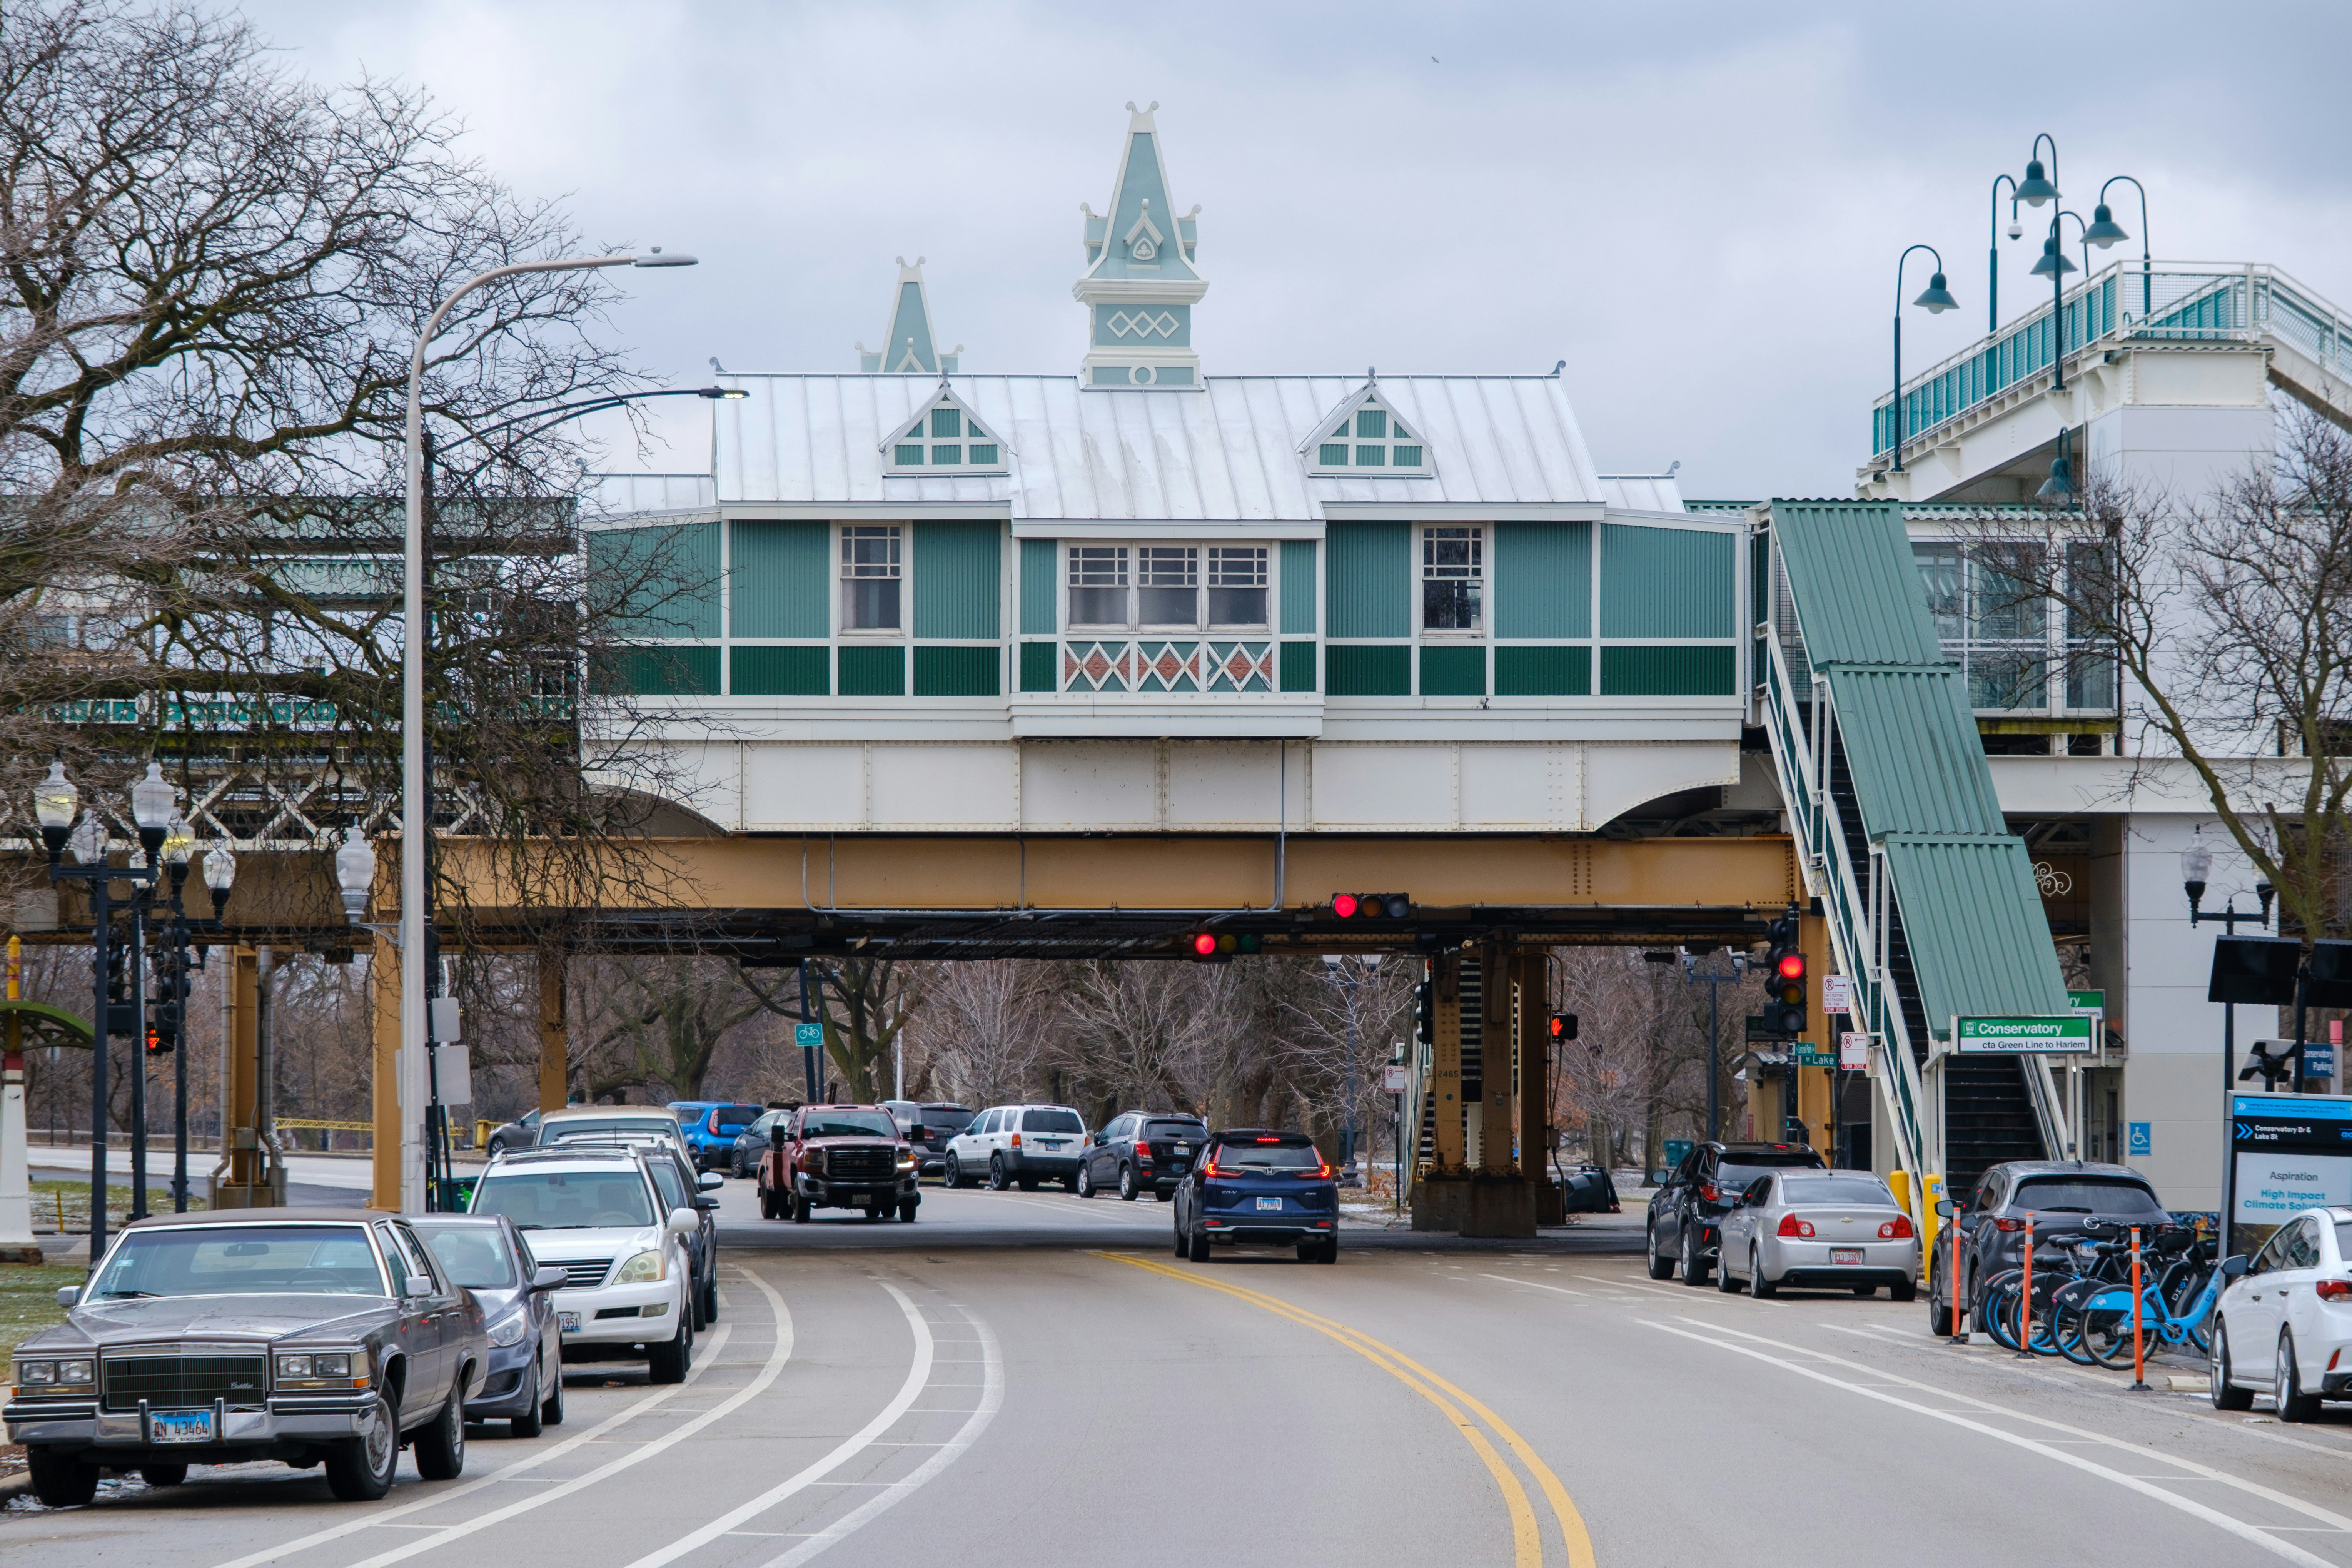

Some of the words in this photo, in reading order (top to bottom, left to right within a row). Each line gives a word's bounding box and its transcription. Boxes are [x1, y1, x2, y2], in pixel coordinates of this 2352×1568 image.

[1978, 1023, 2062, 1036] Conservatory
[2056, 1040, 2085, 1049] Harlem
[1813, 1055, 1835, 1064] Lake
[2304, 1049, 2333, 1061] onservatory
[2313, 1062, 2333, 1074] Parking
[2255, 1125, 2297, 1133] Conservatory
[2270, 1171, 2318, 1181] Aspiration
[2261, 1189, 2285, 1199] High
[2288, 1191, 2325, 1200] Impact
[2244, 1200, 2286, 1210] Climate
[154, 1422, 167, 1437] AN
[175, 1421, 208, 1436] 43464
